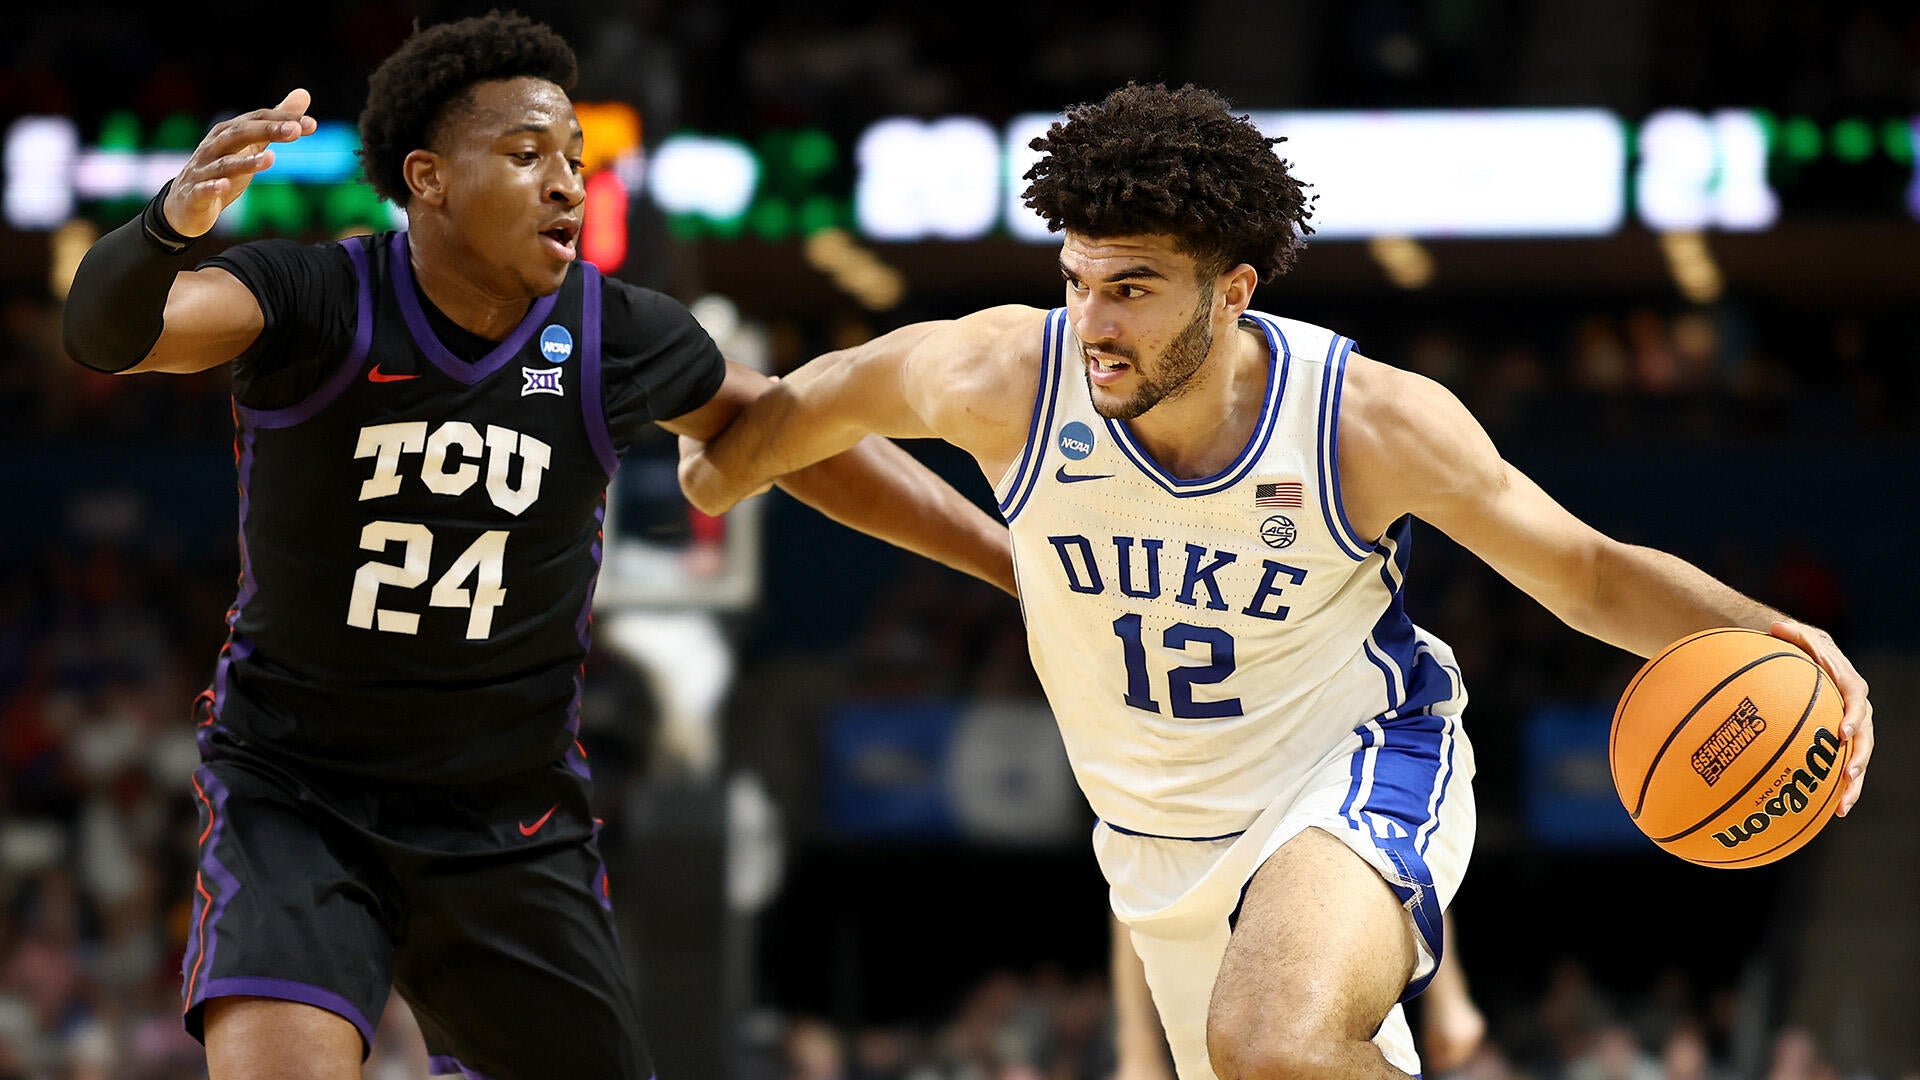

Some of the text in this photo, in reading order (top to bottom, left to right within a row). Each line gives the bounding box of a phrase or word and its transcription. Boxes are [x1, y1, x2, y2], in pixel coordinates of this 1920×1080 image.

[525, 371, 560, 392] XII
[353, 421, 552, 516] TCU
[1061, 437, 1090, 455] NCAA
[1262, 526, 1295, 537] ACC
[347, 520, 510, 640] 24
[1048, 535, 1308, 621] DUKE
[1113, 613, 1244, 718] 12
[1692, 719, 1741, 773] MADNESS
[1718, 724, 1756, 767] MARCH
[1711, 727, 1841, 848] Wilson
[1755, 788, 1773, 806] NXT
[1774, 767, 1792, 787] EVO
